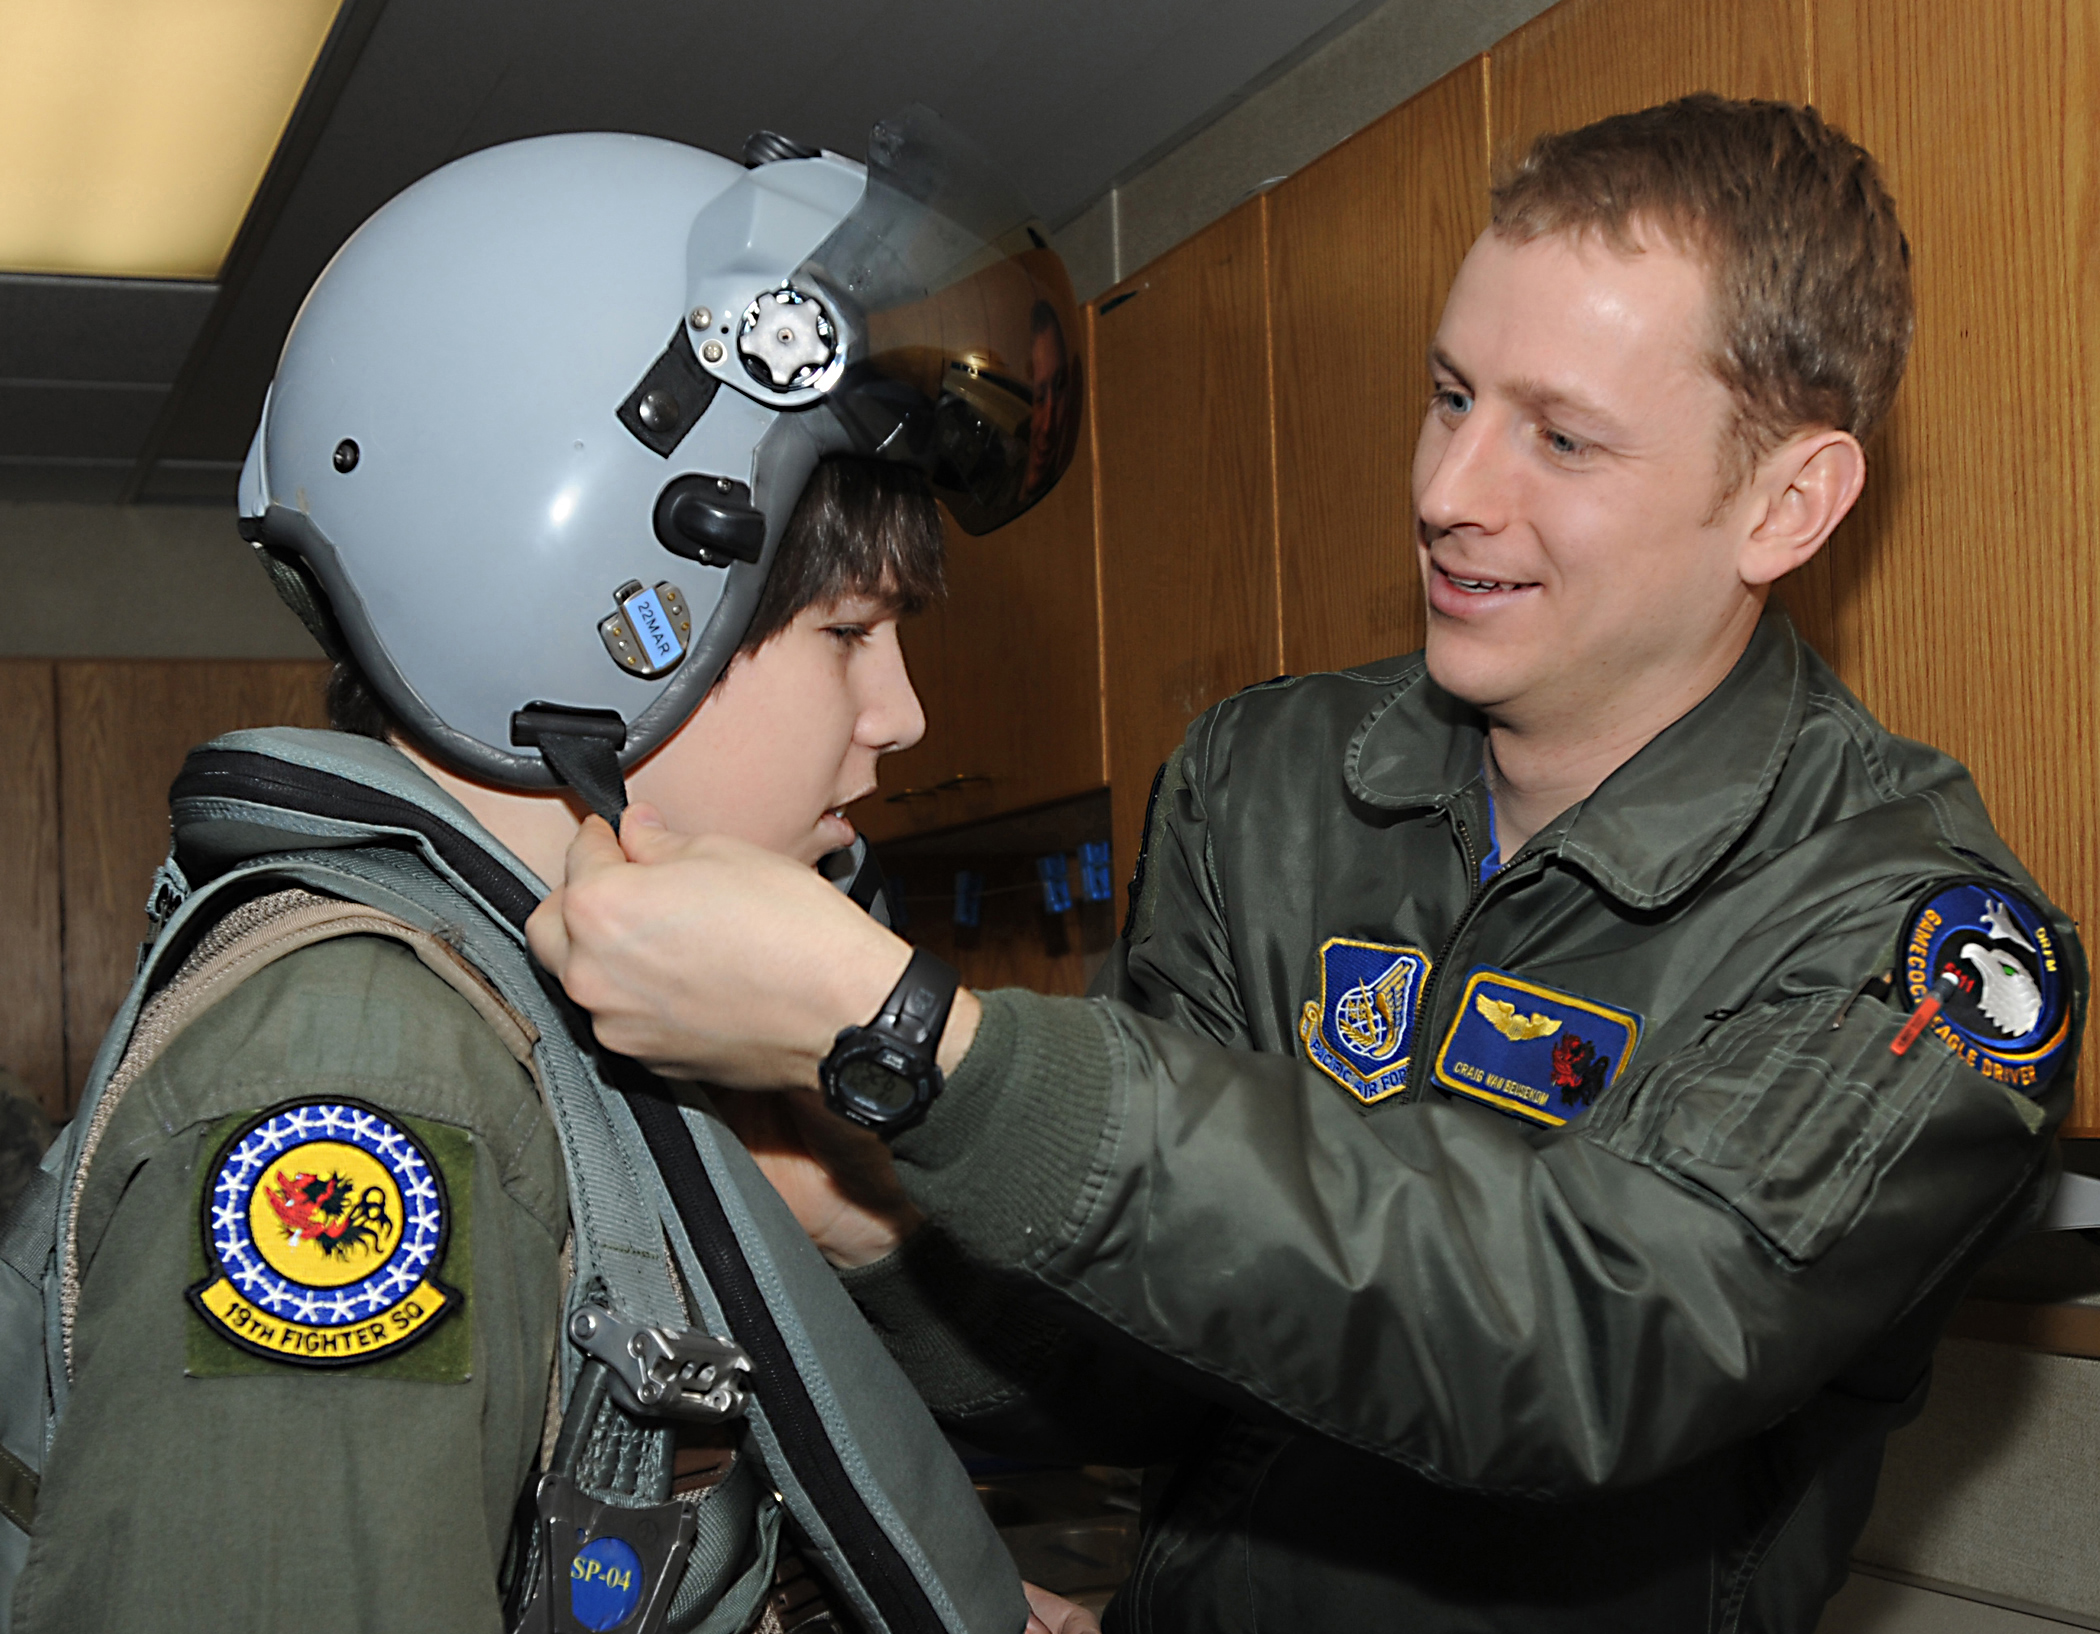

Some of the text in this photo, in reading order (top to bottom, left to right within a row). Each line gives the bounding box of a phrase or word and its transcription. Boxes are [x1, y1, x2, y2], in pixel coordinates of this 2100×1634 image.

[637, 601, 670, 656] 22MAR
[1907, 909, 1942, 1003] GAMECOC
[1310, 1038, 1352, 1082] PACIFIC
[1354, 1081, 1378, 1099] AIR
[1454, 1061, 1485, 1083] CRAIG
[1485, 1073, 1505, 1090] VAN
[1982, 1058, 2037, 1086] DRIVER
[225, 1301, 424, 1352] 19TH FIGHTER SQ
[570, 1556, 632, 1592] SP-04
